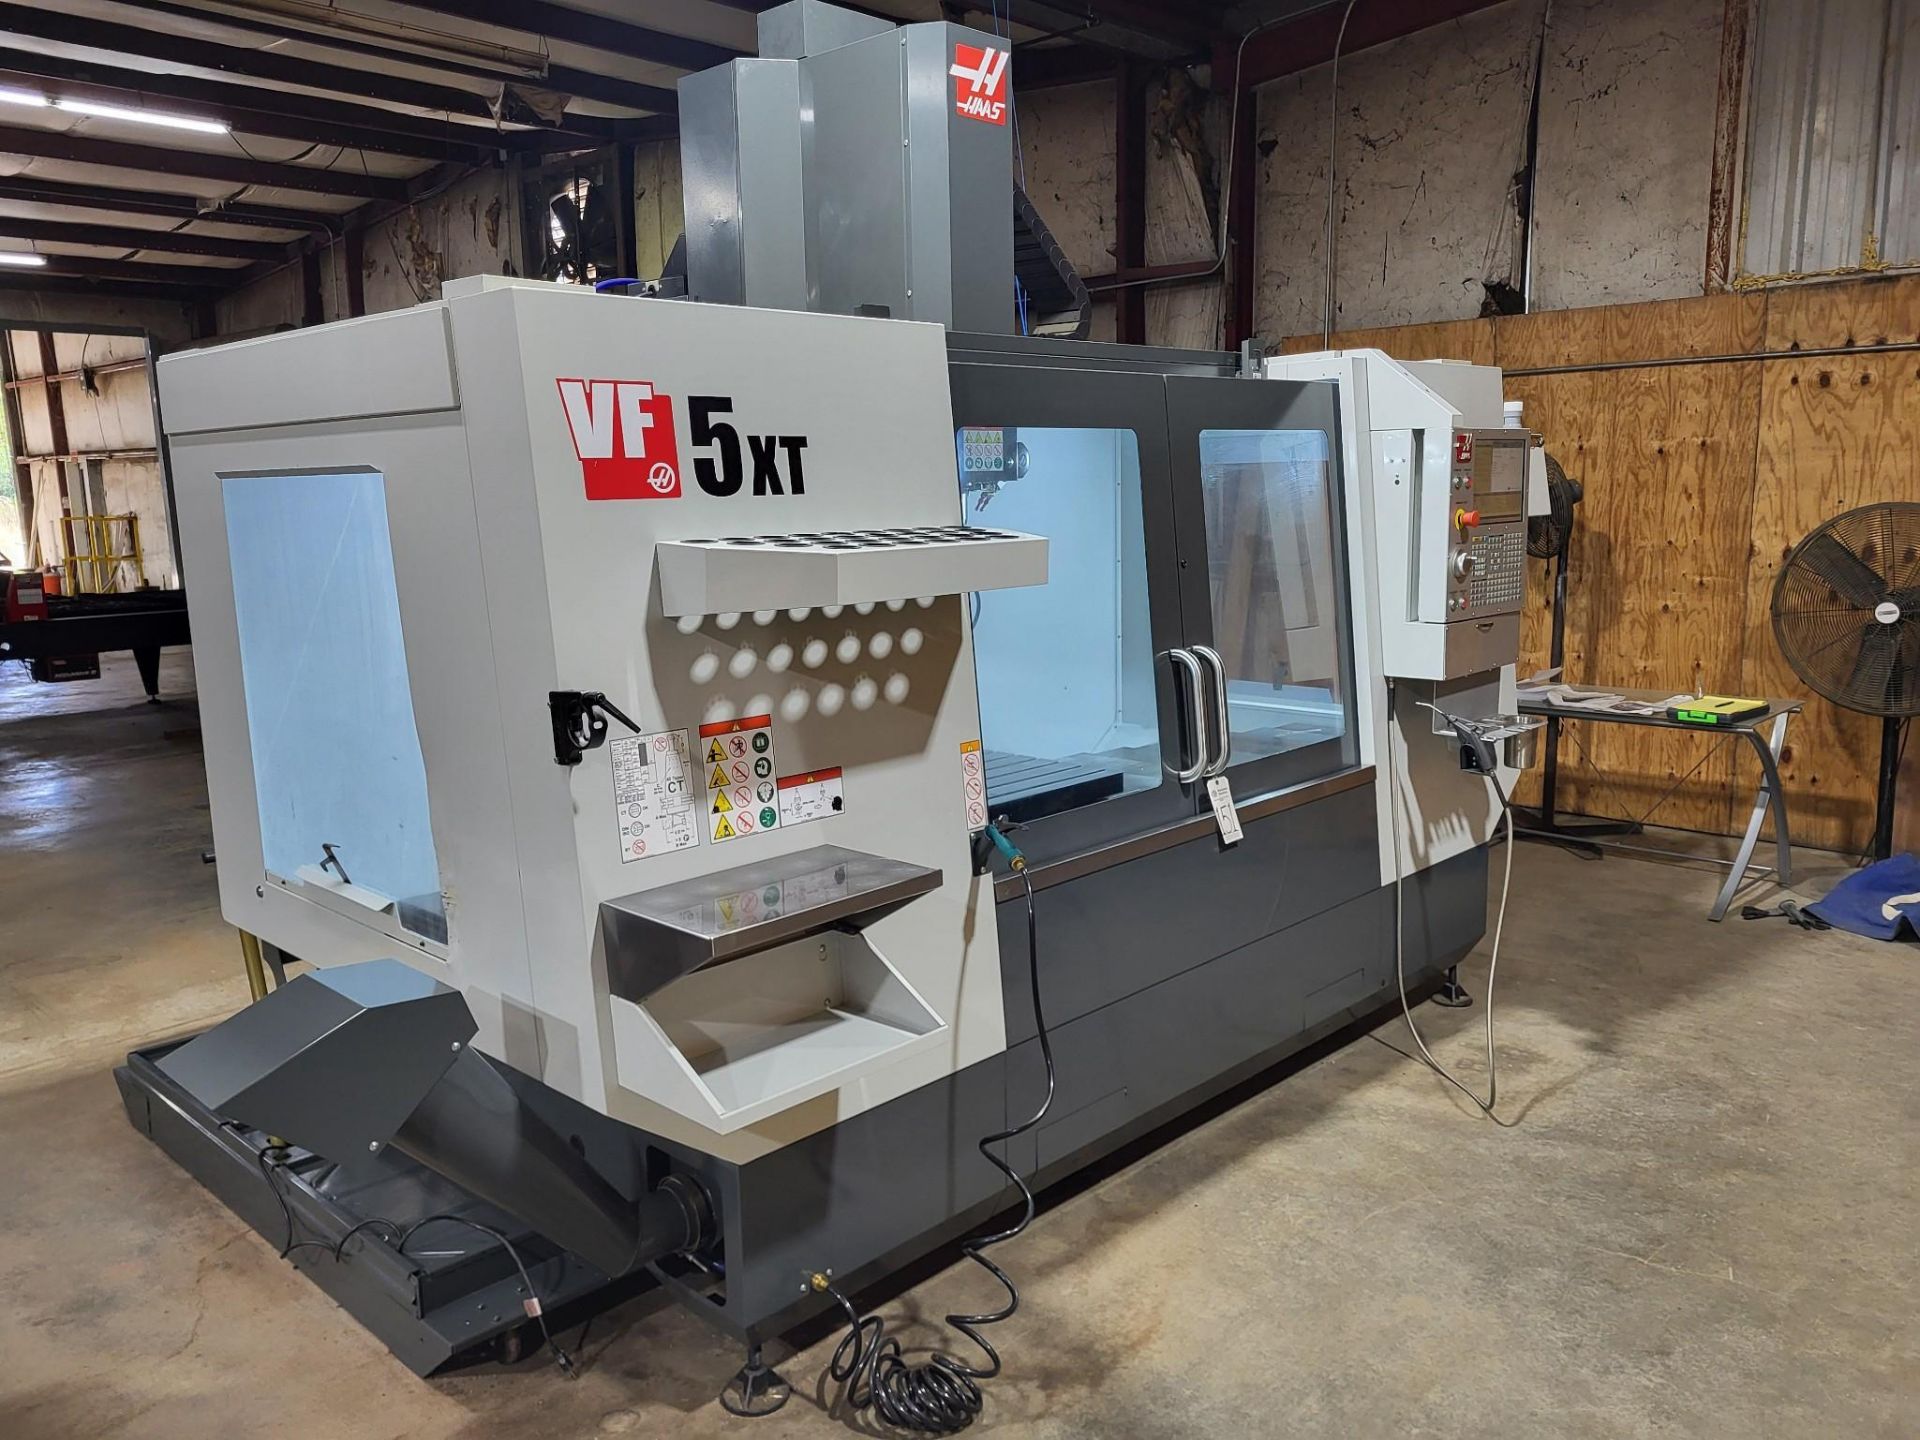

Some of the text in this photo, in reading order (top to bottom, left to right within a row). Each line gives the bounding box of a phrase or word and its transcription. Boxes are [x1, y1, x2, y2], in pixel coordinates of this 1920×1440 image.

[957, 95, 1006, 120] HAAS
[557, 379, 656, 459] VF
[667, 780, 685, 793] CT
